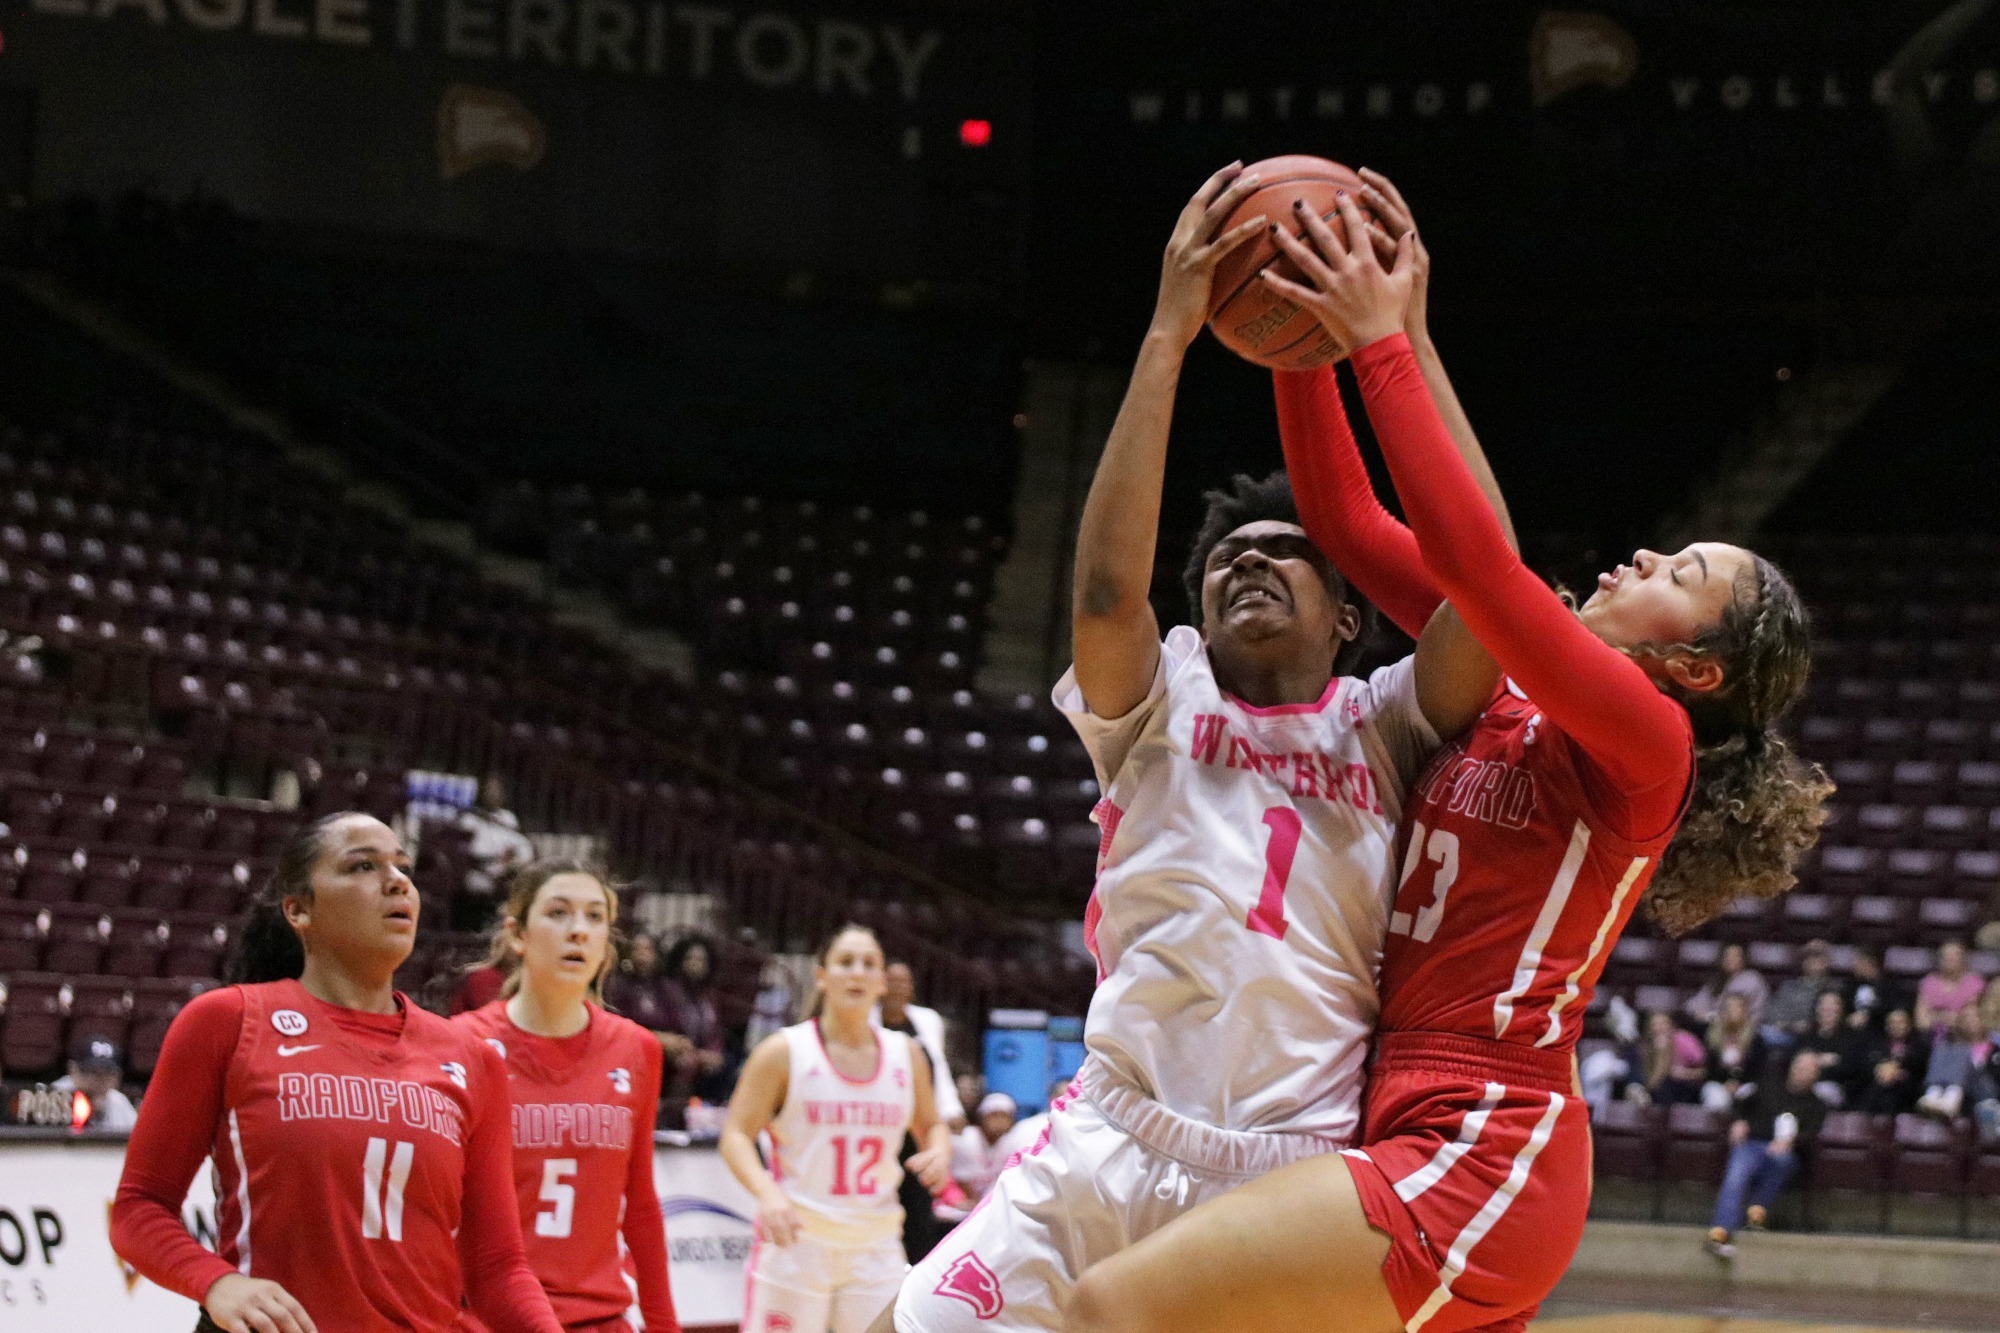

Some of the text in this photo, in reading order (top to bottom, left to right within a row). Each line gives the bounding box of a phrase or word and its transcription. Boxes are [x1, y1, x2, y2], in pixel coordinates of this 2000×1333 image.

[1246, 805, 1302, 941] 1
[1389, 820, 1459, 943] 23
[277, 1016, 303, 1031] CC
[362, 1137, 414, 1242] 11
[534, 1158, 578, 1239] 5
[830, 1136, 885, 1196] 12
